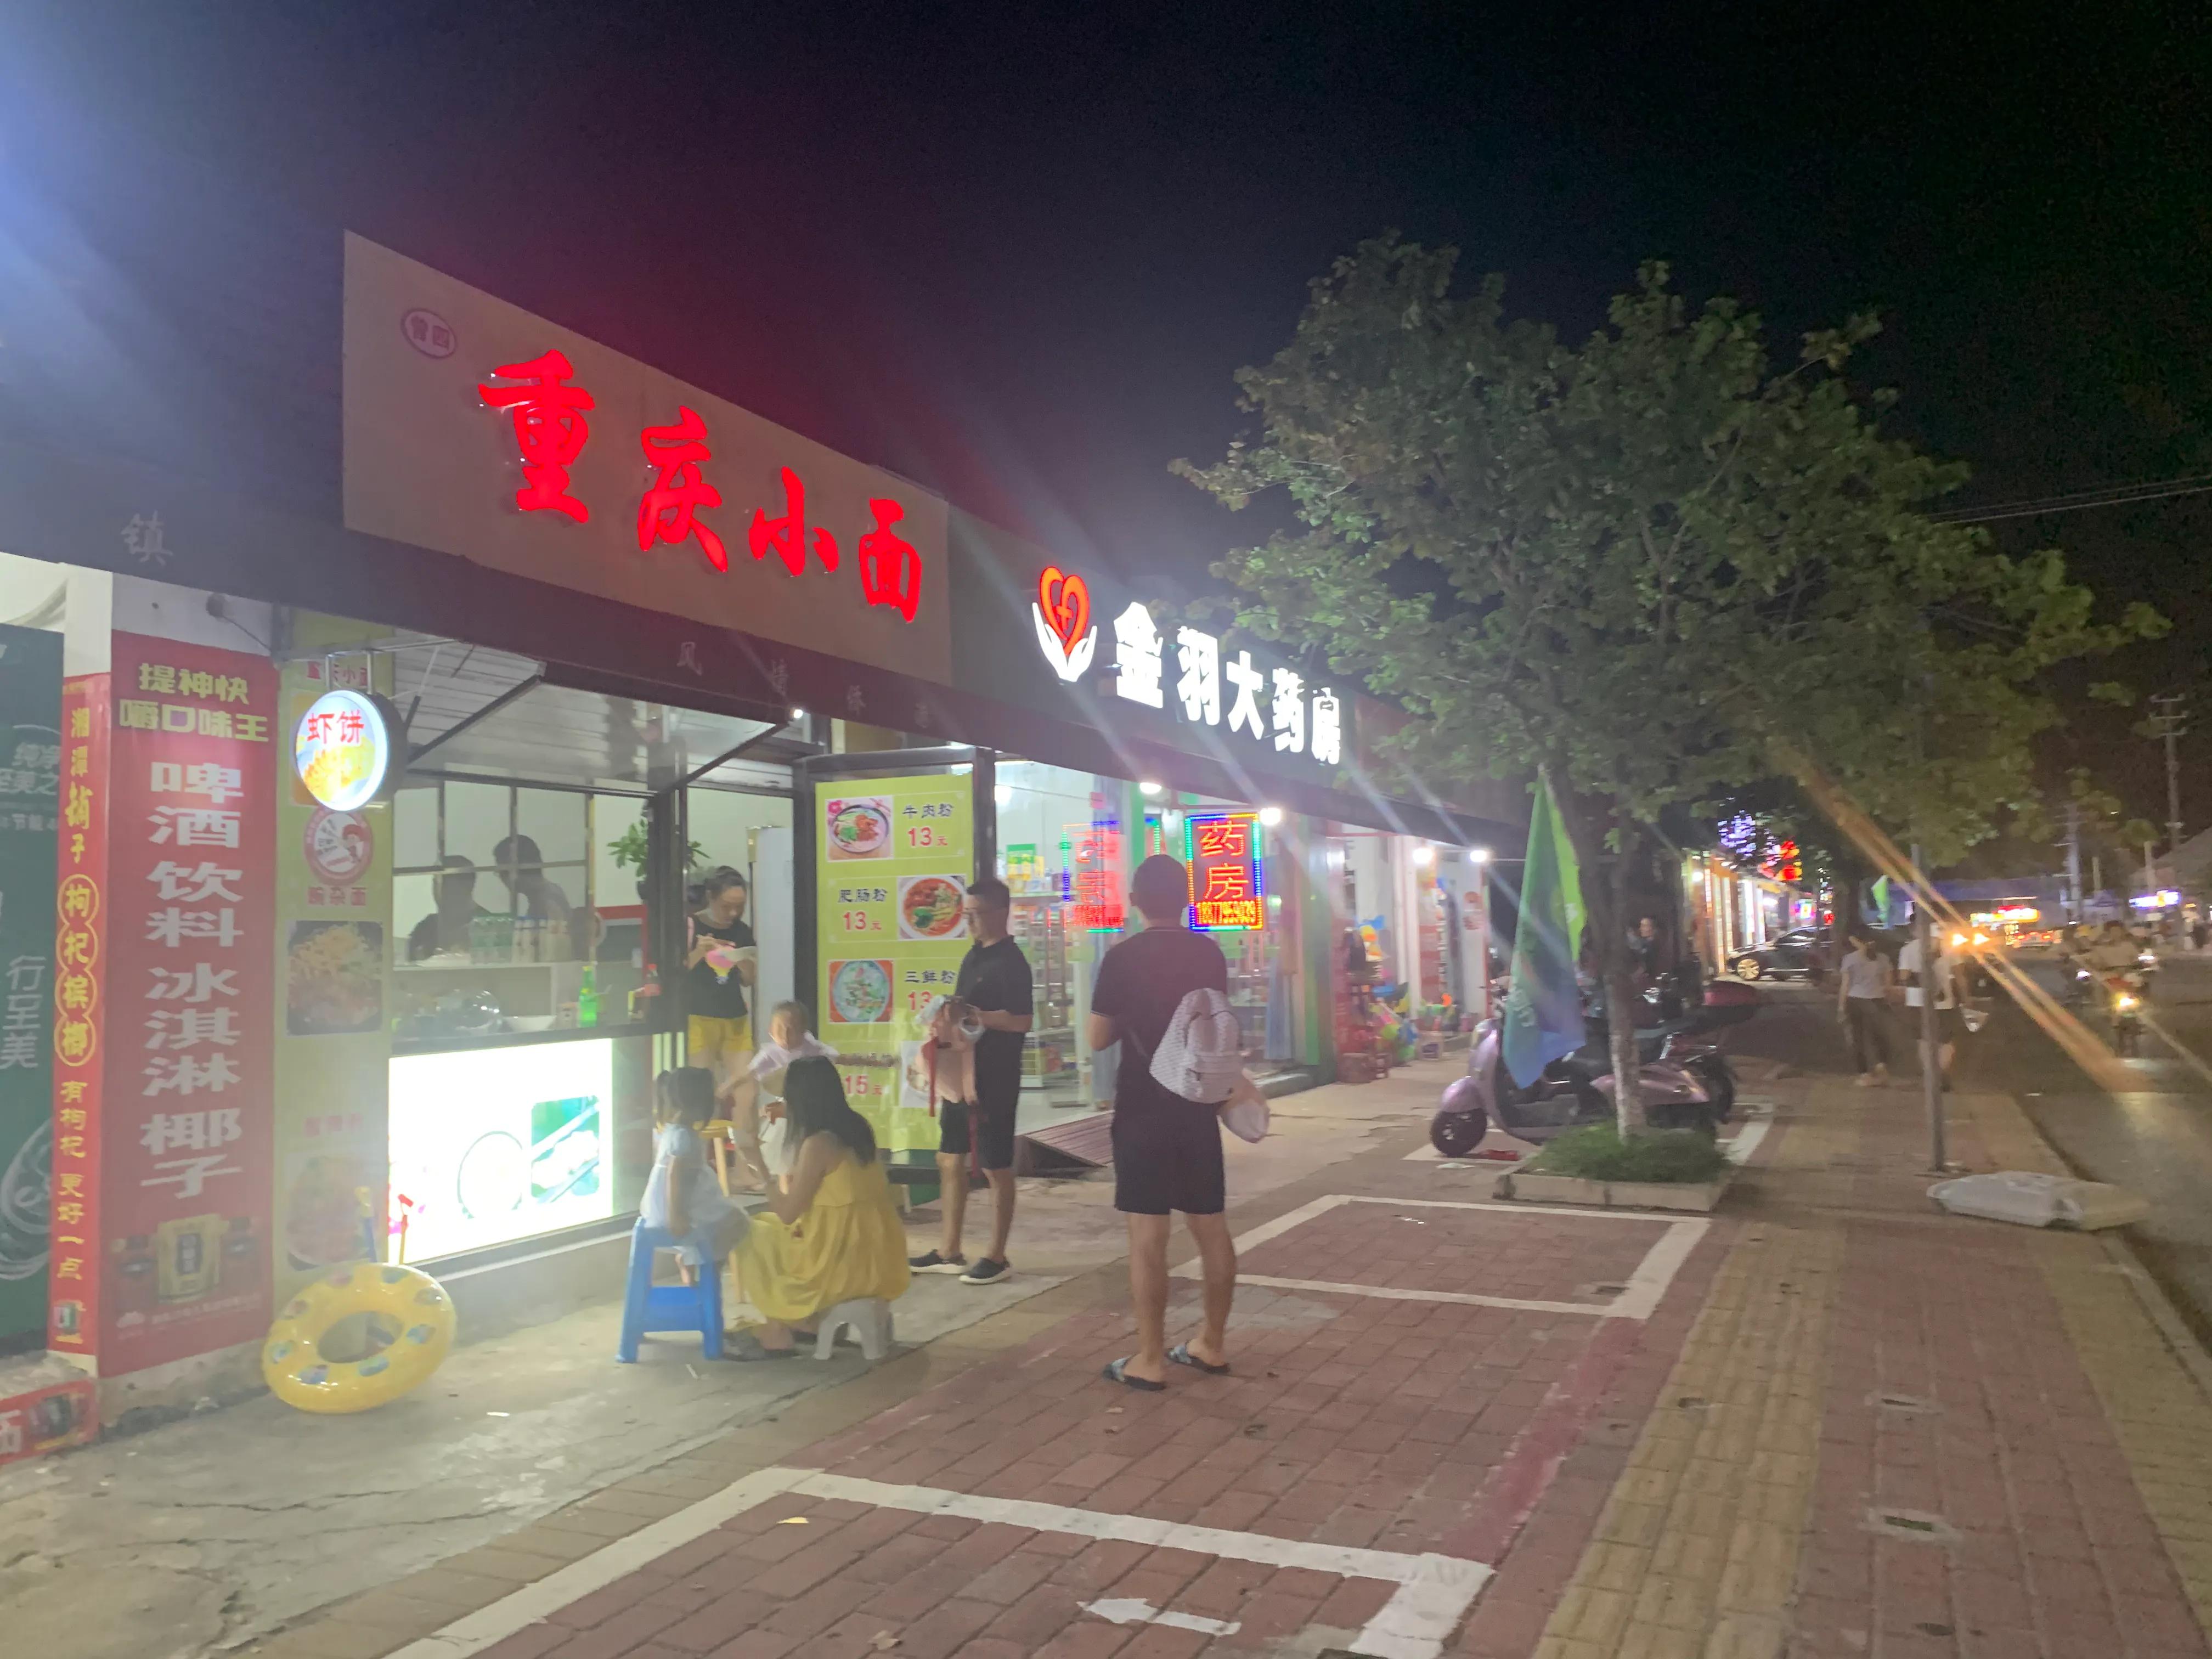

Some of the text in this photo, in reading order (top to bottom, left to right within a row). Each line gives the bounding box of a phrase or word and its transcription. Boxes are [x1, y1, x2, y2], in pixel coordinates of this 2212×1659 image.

[478, 349, 922, 623] 重庆小面
[139, 663, 249, 705] 提神快
[119, 699, 269, 742] 嚼口味王
[307, 710, 365, 744] 虾饼
[902, 804, 954, 819] 牛肉粉
[1198, 820, 1249, 900] 药房
[838, 888, 888, 902] 肥肠粉
[905, 970, 955, 984] 三鲜粉
